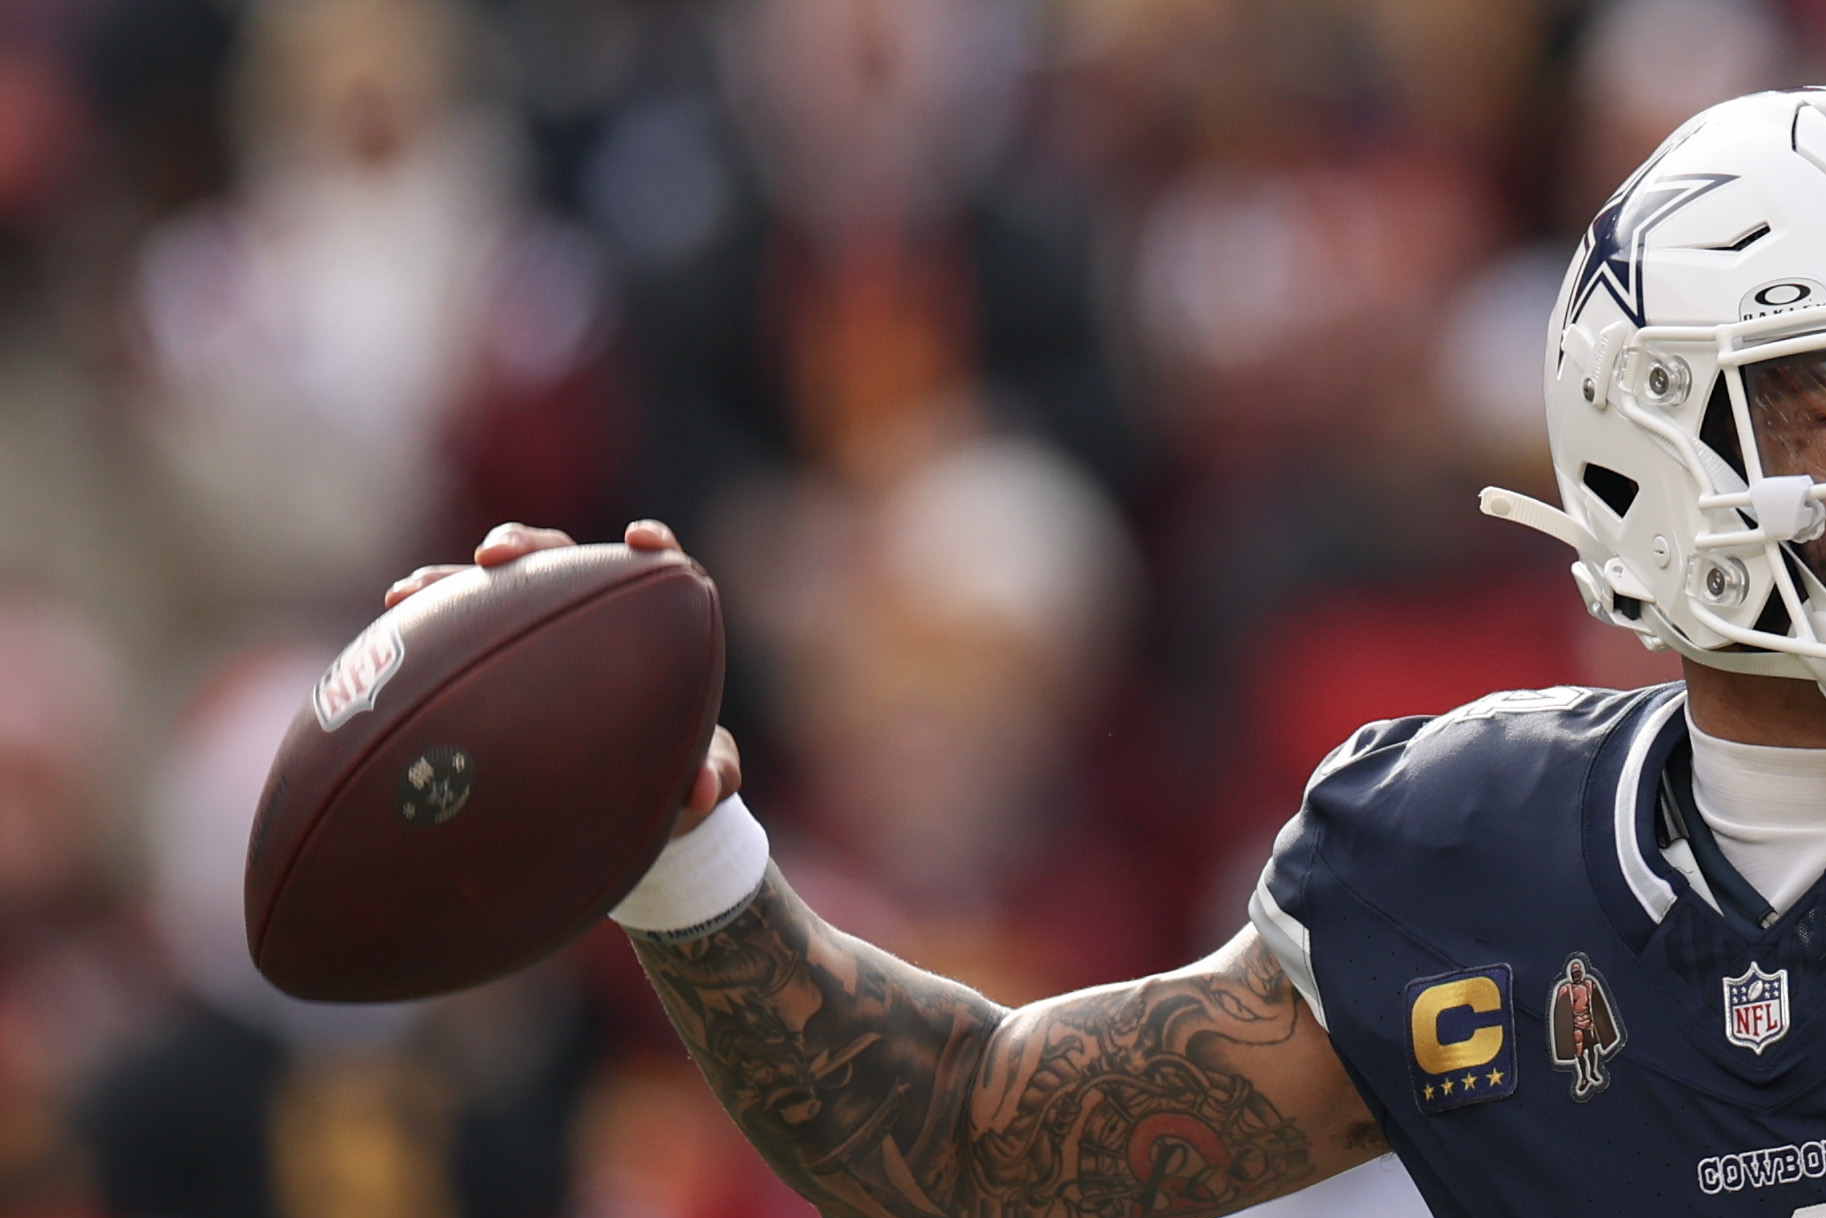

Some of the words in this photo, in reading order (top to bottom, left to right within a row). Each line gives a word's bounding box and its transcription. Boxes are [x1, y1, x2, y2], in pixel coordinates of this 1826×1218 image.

[325, 644, 393, 714] NFL
[1410, 976, 1505, 1076] C
[1734, 1003, 1779, 1037] NFL
